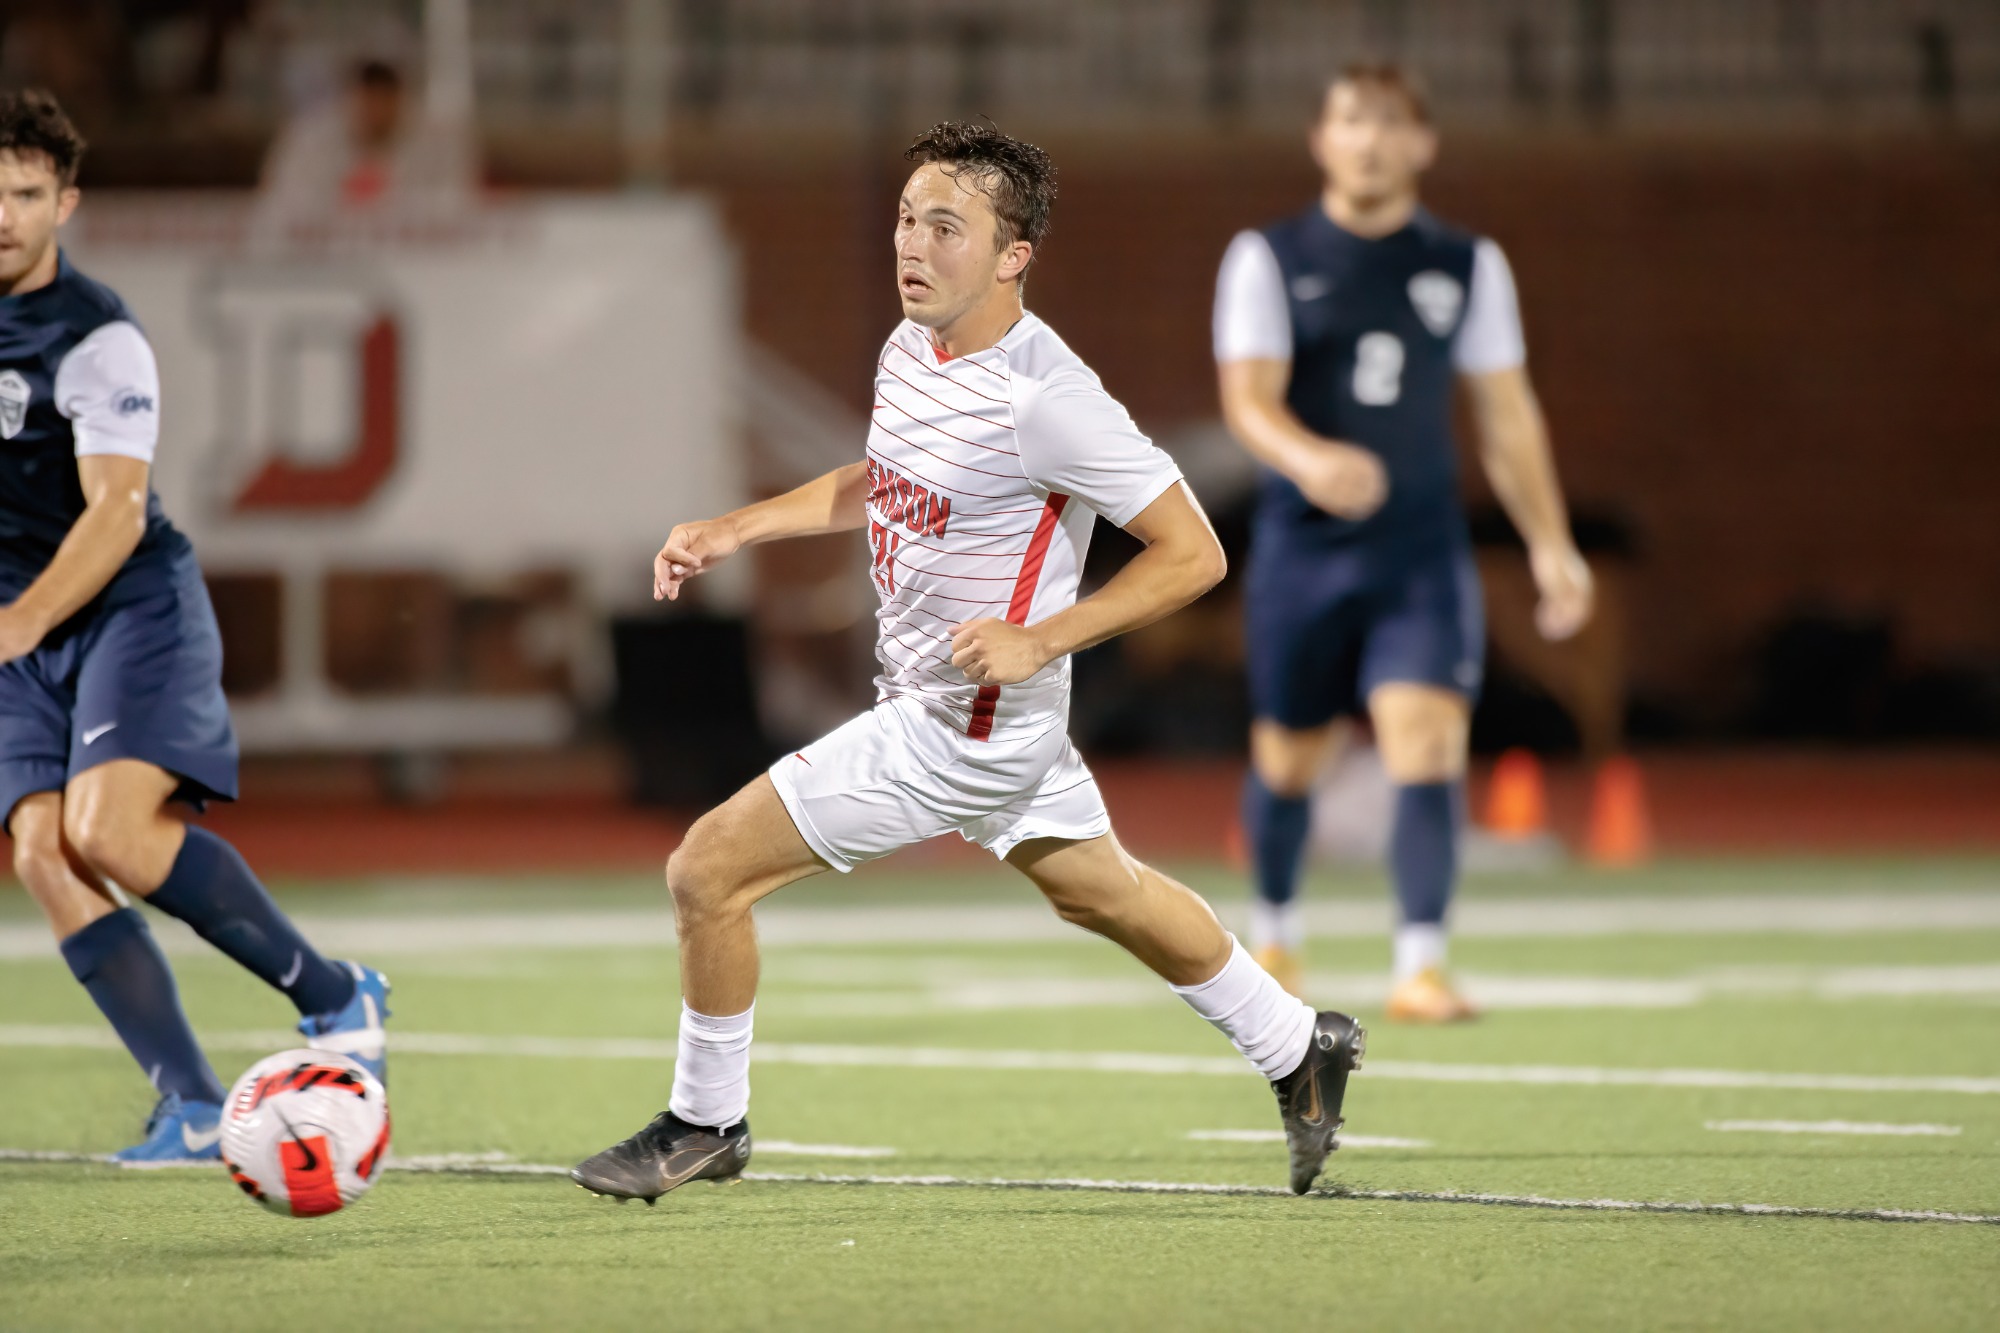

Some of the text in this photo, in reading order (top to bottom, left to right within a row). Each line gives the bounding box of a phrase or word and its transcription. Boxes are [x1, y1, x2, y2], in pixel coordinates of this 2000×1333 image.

[1354, 331, 1405, 406] 2
[866, 456, 952, 540] ENISON
[871, 520, 899, 596] 21
